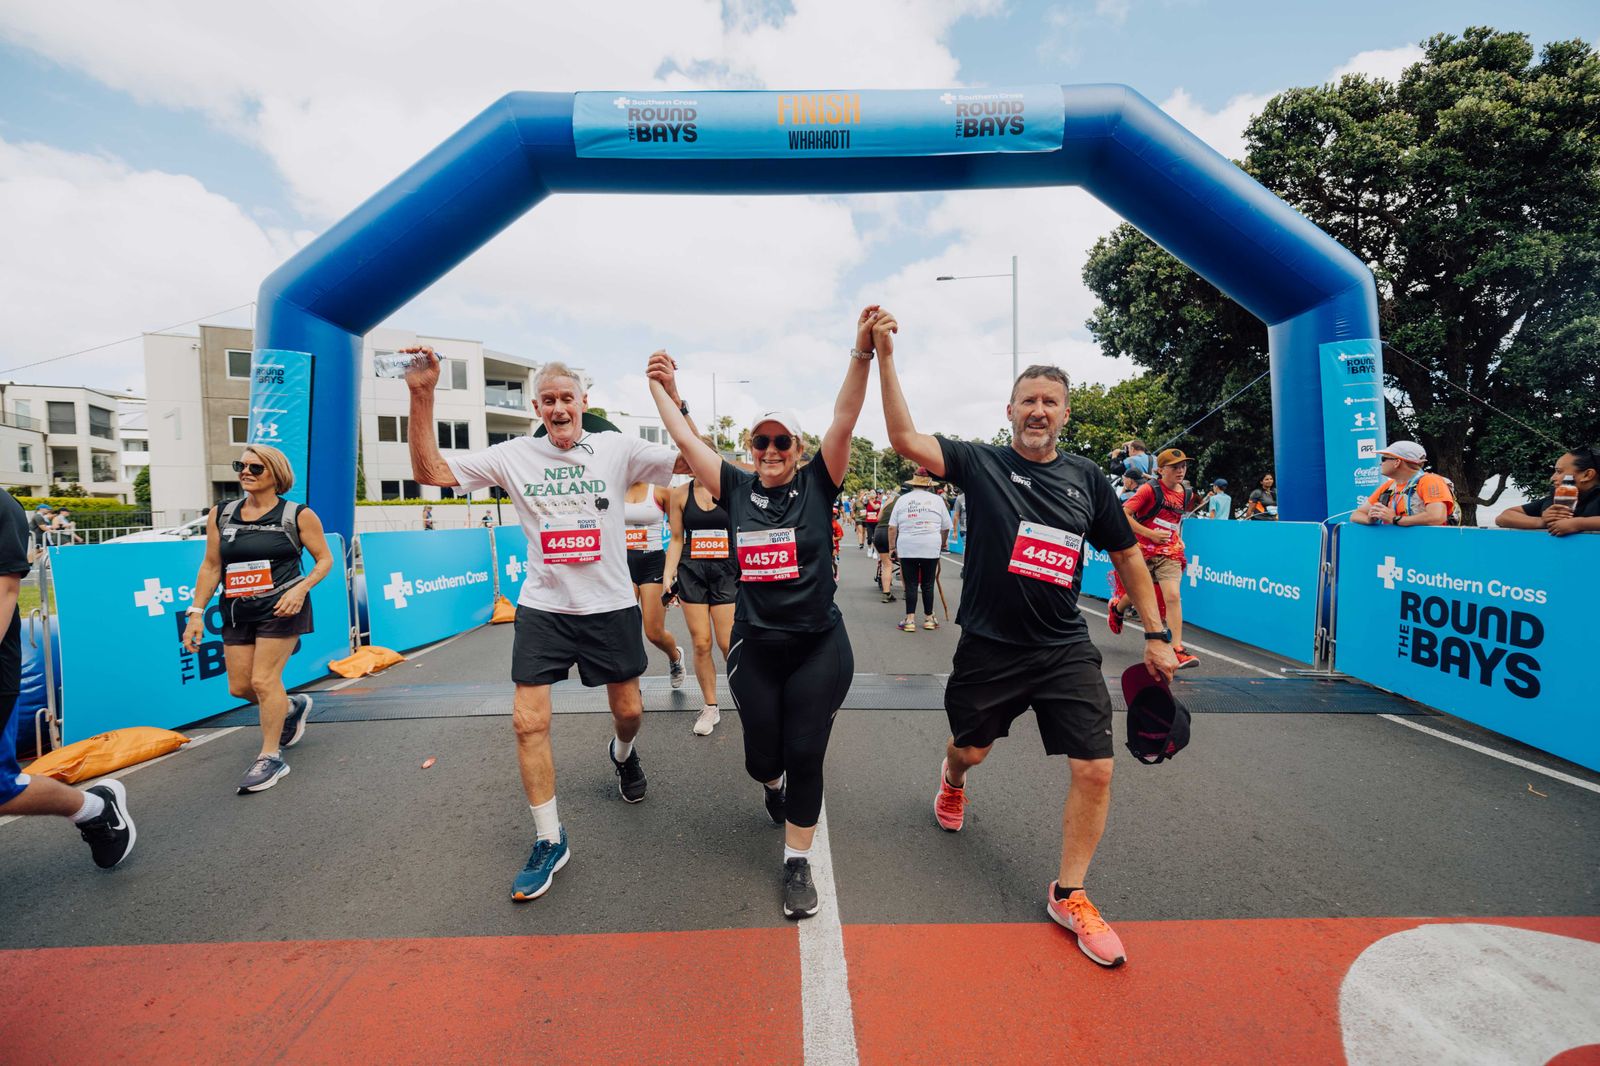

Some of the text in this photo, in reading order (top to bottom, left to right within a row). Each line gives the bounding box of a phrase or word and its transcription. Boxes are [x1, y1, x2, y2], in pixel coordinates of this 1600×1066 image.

[628, 107, 697, 121] ROUND
[778, 93, 860, 125] FINISH
[956, 100, 1025, 117] ROUND
[628, 121, 636, 143] THE
[636, 122, 698, 143] BAYS
[955, 119, 963, 139] THE
[962, 115, 1025, 138] BAYS
[788, 129, 851, 150] WHAKAOTI
[256, 368, 285, 376] ROUND
[1346, 359, 1376, 367] ROUND
[1351, 365, 1376, 374] BAYS
[258, 375, 285, 385] BAYS
[543, 465, 585, 481] NEW
[523, 479, 607, 497] ZEALAND
[547, 535, 596, 550] 44580
[626, 532, 643, 541] 083
[695, 541, 725, 549] 26084
[771, 536, 791, 544] BAYS
[744, 550, 790, 567] 44578
[1022, 545, 1074, 571] 44579
[230, 573, 263, 586] 21207
[415, 570, 488, 595] Southern Cross
[1204, 566, 1300, 600] Southern Cross
[1406, 568, 1547, 604] Southern Cross
[1400, 590, 1545, 649] ROUND
[1398, 623, 1410, 659] THE
[179, 647, 196, 686] THE
[1411, 627, 1541, 699] BAYS
